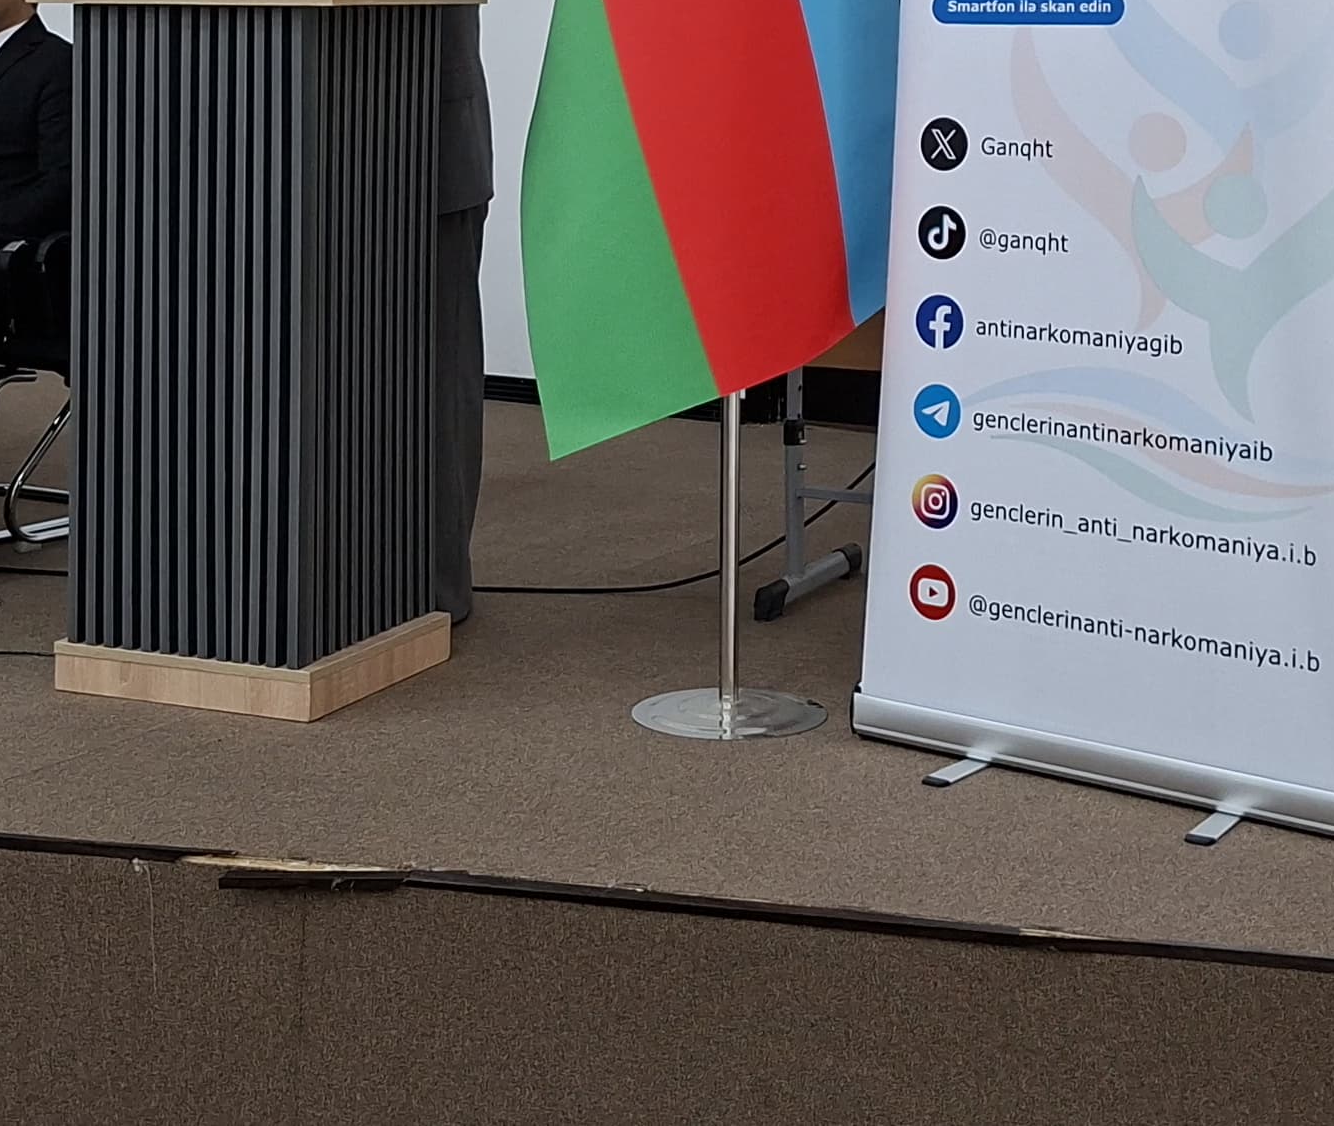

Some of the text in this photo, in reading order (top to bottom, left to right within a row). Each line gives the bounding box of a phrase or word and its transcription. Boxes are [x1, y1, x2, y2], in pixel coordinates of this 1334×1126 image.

[947, 0, 1111, 12] Smartfon ilə skan edin
[981, 136, 1053, 161] Ganqht
[979, 228, 1068, 256] @ganqht
[976, 319, 1182, 357] antinarkomaniyagib
[973, 412, 1272, 462] genclerinantinarkomaniyaib
[970, 502, 1316, 566] genclerin_anti_narkomaniya.i.b
[969, 594, 1320, 672] @genclerinanti-narkomaniya.i.b
